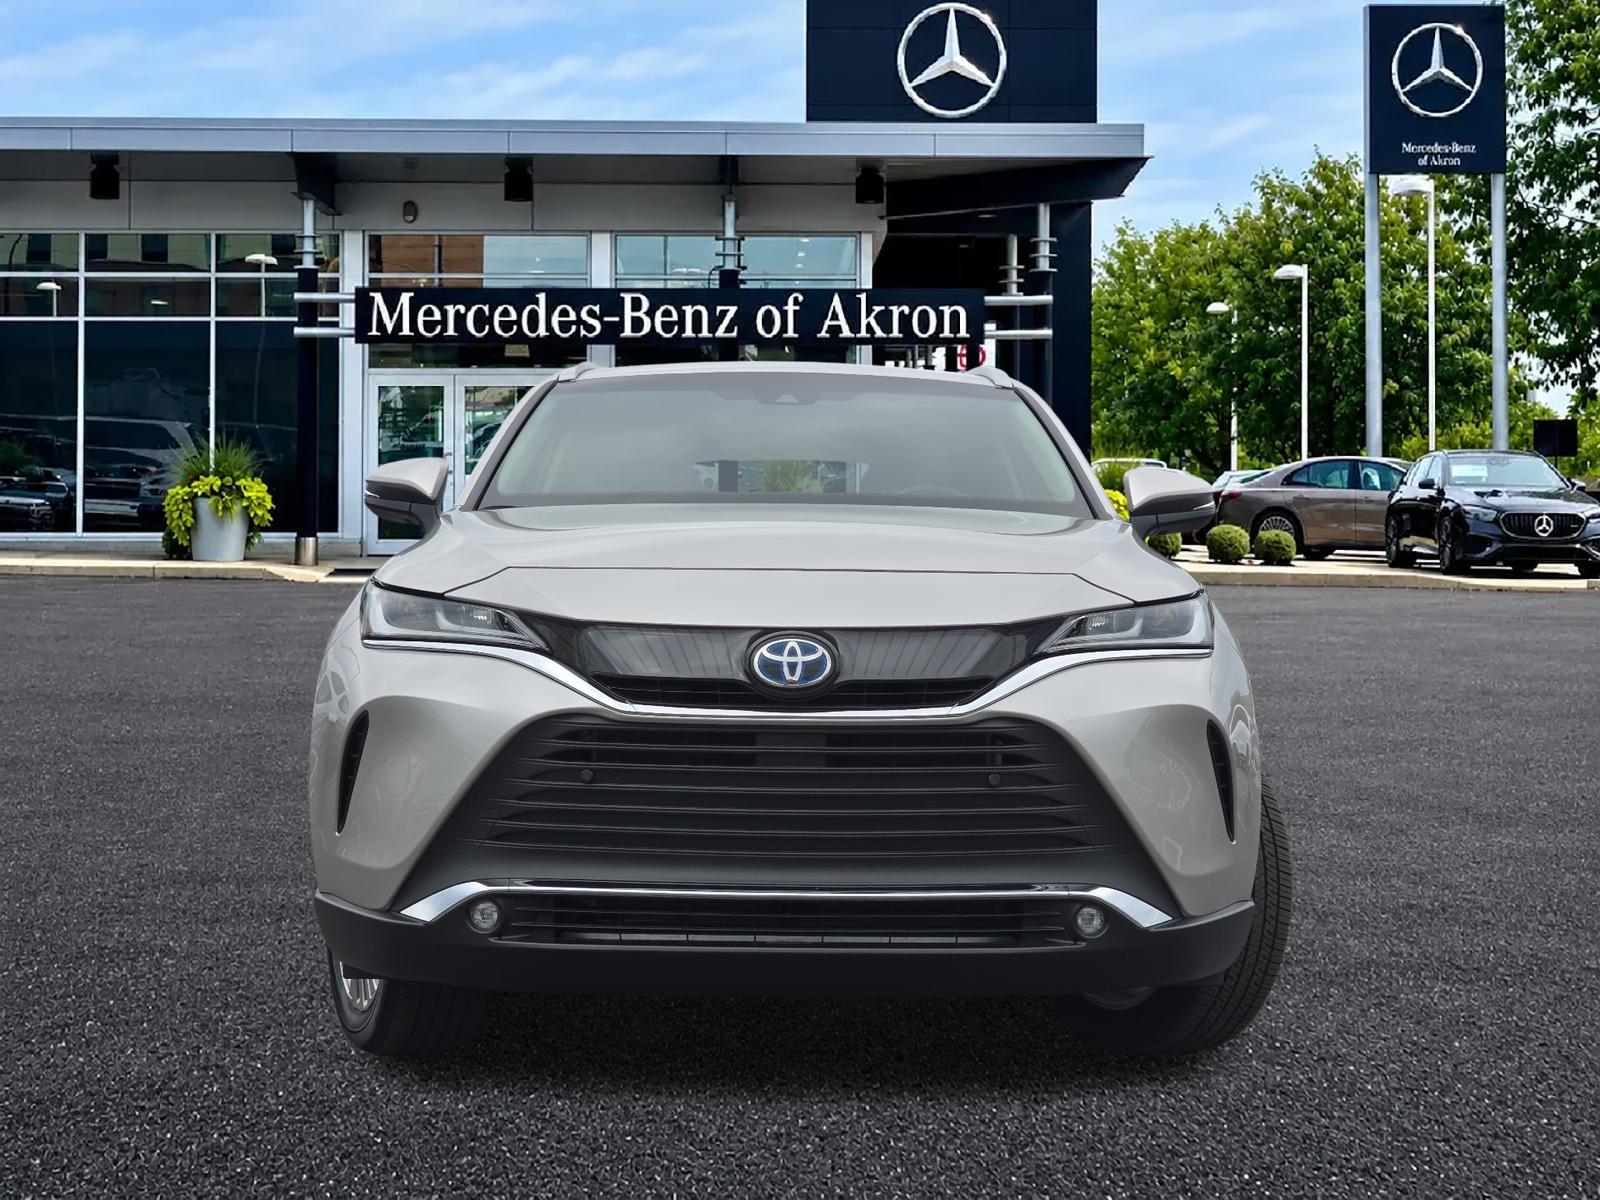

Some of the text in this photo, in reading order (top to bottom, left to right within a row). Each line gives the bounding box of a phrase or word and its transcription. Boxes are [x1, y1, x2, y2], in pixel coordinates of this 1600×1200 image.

[1401, 142, 1476, 153] Mercedes-Benz
[1417, 155, 1461, 166] of Akron
[367, 291, 971, 338] Mercedes-Benz of Akron
